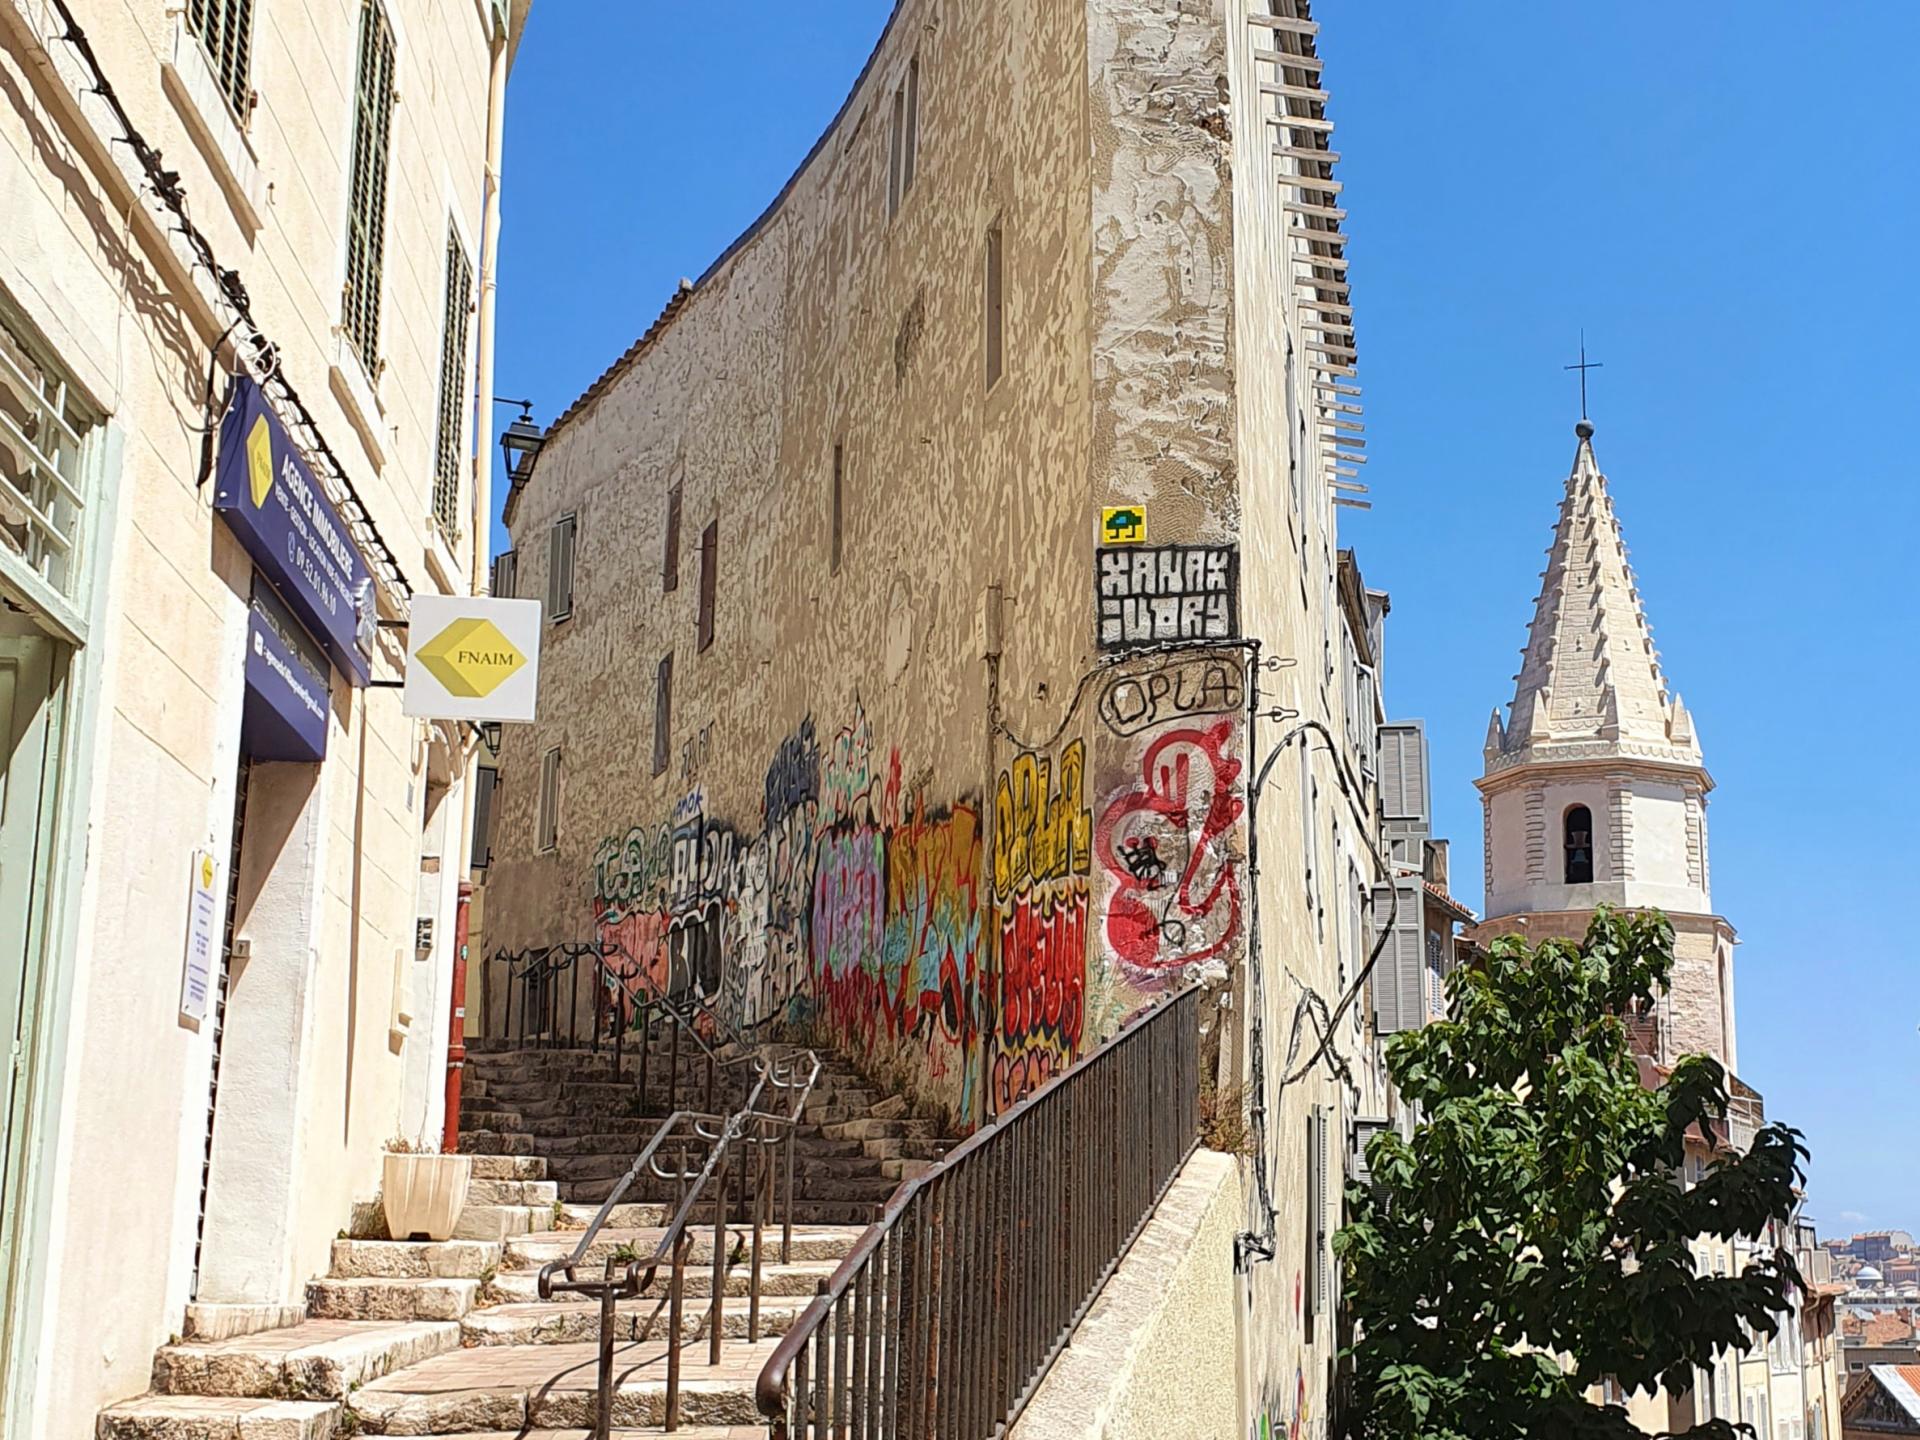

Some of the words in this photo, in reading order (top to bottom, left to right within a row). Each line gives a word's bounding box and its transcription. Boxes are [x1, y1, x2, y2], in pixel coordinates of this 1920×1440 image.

[281, 453, 314, 519] AGENCE
[1099, 549, 1232, 597] XANAX
[458, 650, 514, 666] FNAIM
